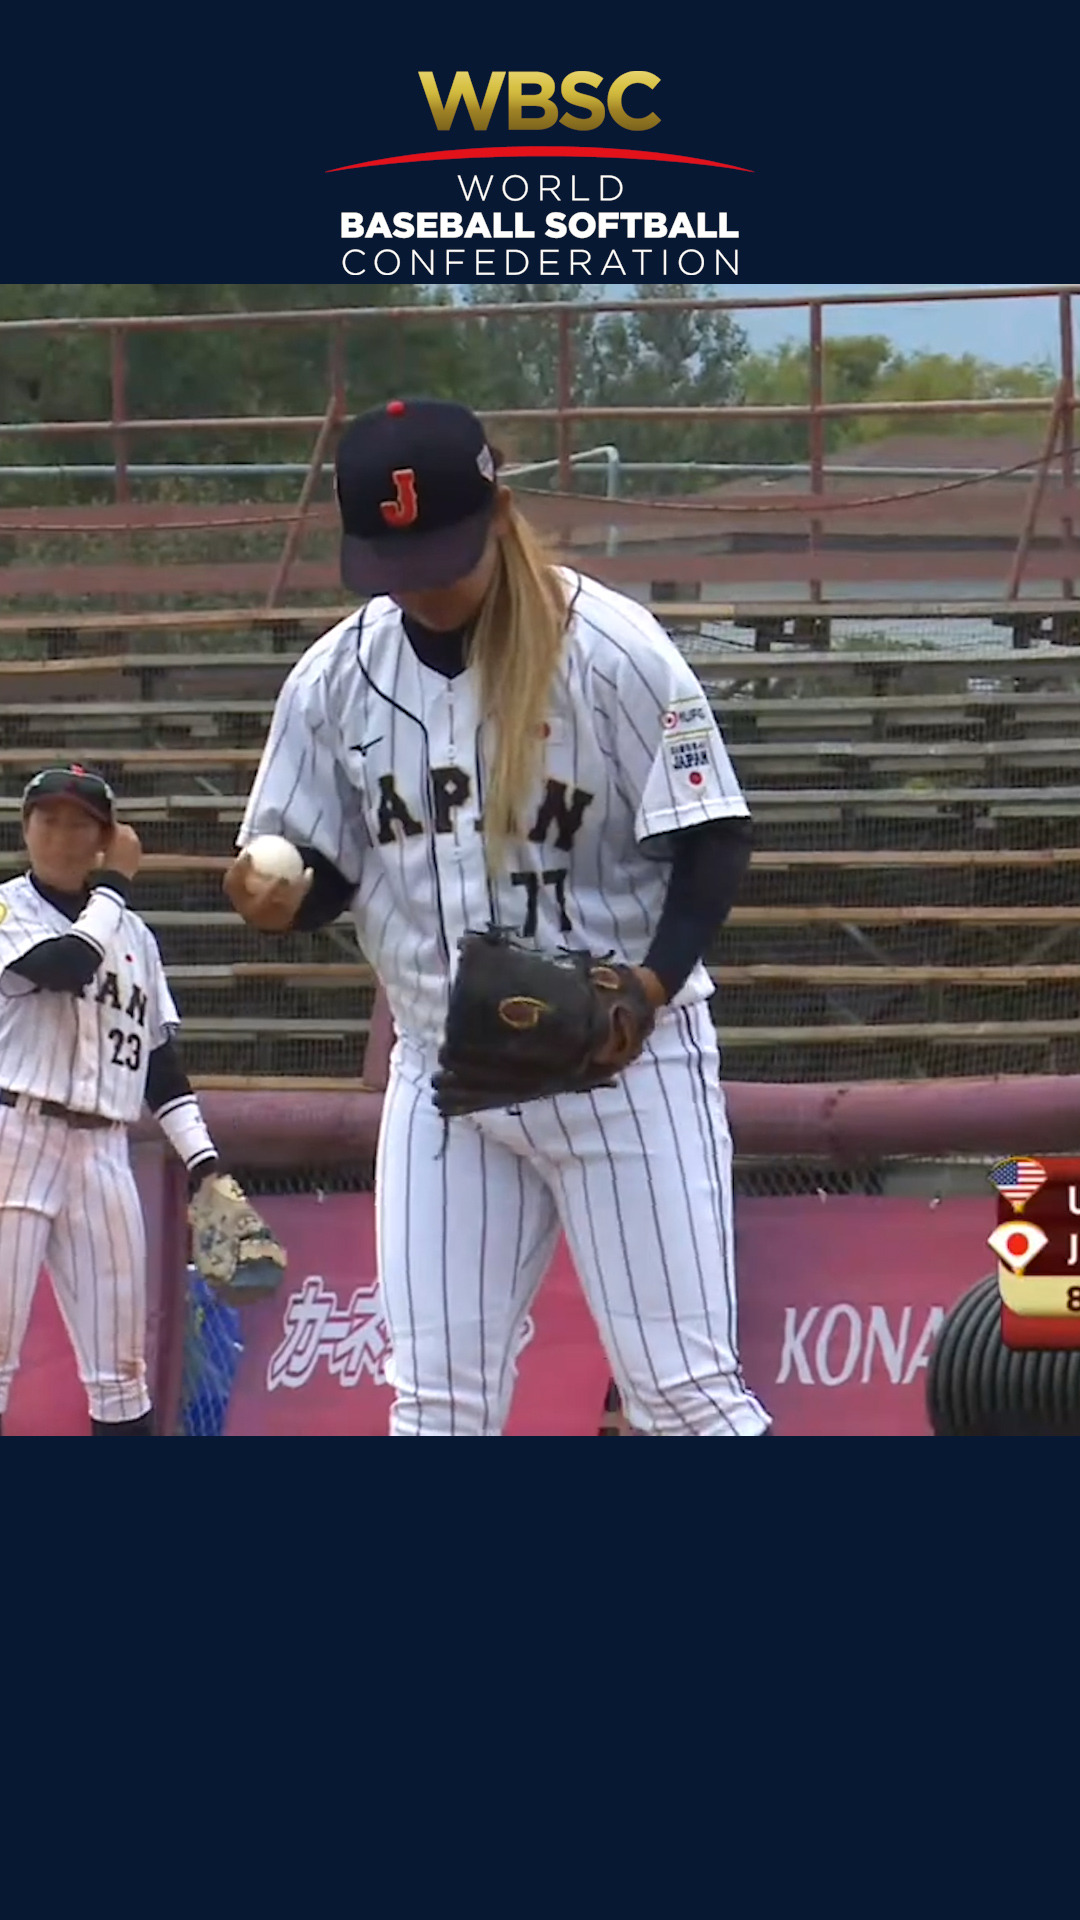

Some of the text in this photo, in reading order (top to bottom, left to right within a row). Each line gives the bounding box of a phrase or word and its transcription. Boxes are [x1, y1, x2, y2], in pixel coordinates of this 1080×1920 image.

[380, 468, 418, 527] J
[511, 868, 573, 938] 77
[108, 1027, 142, 1071] 23
